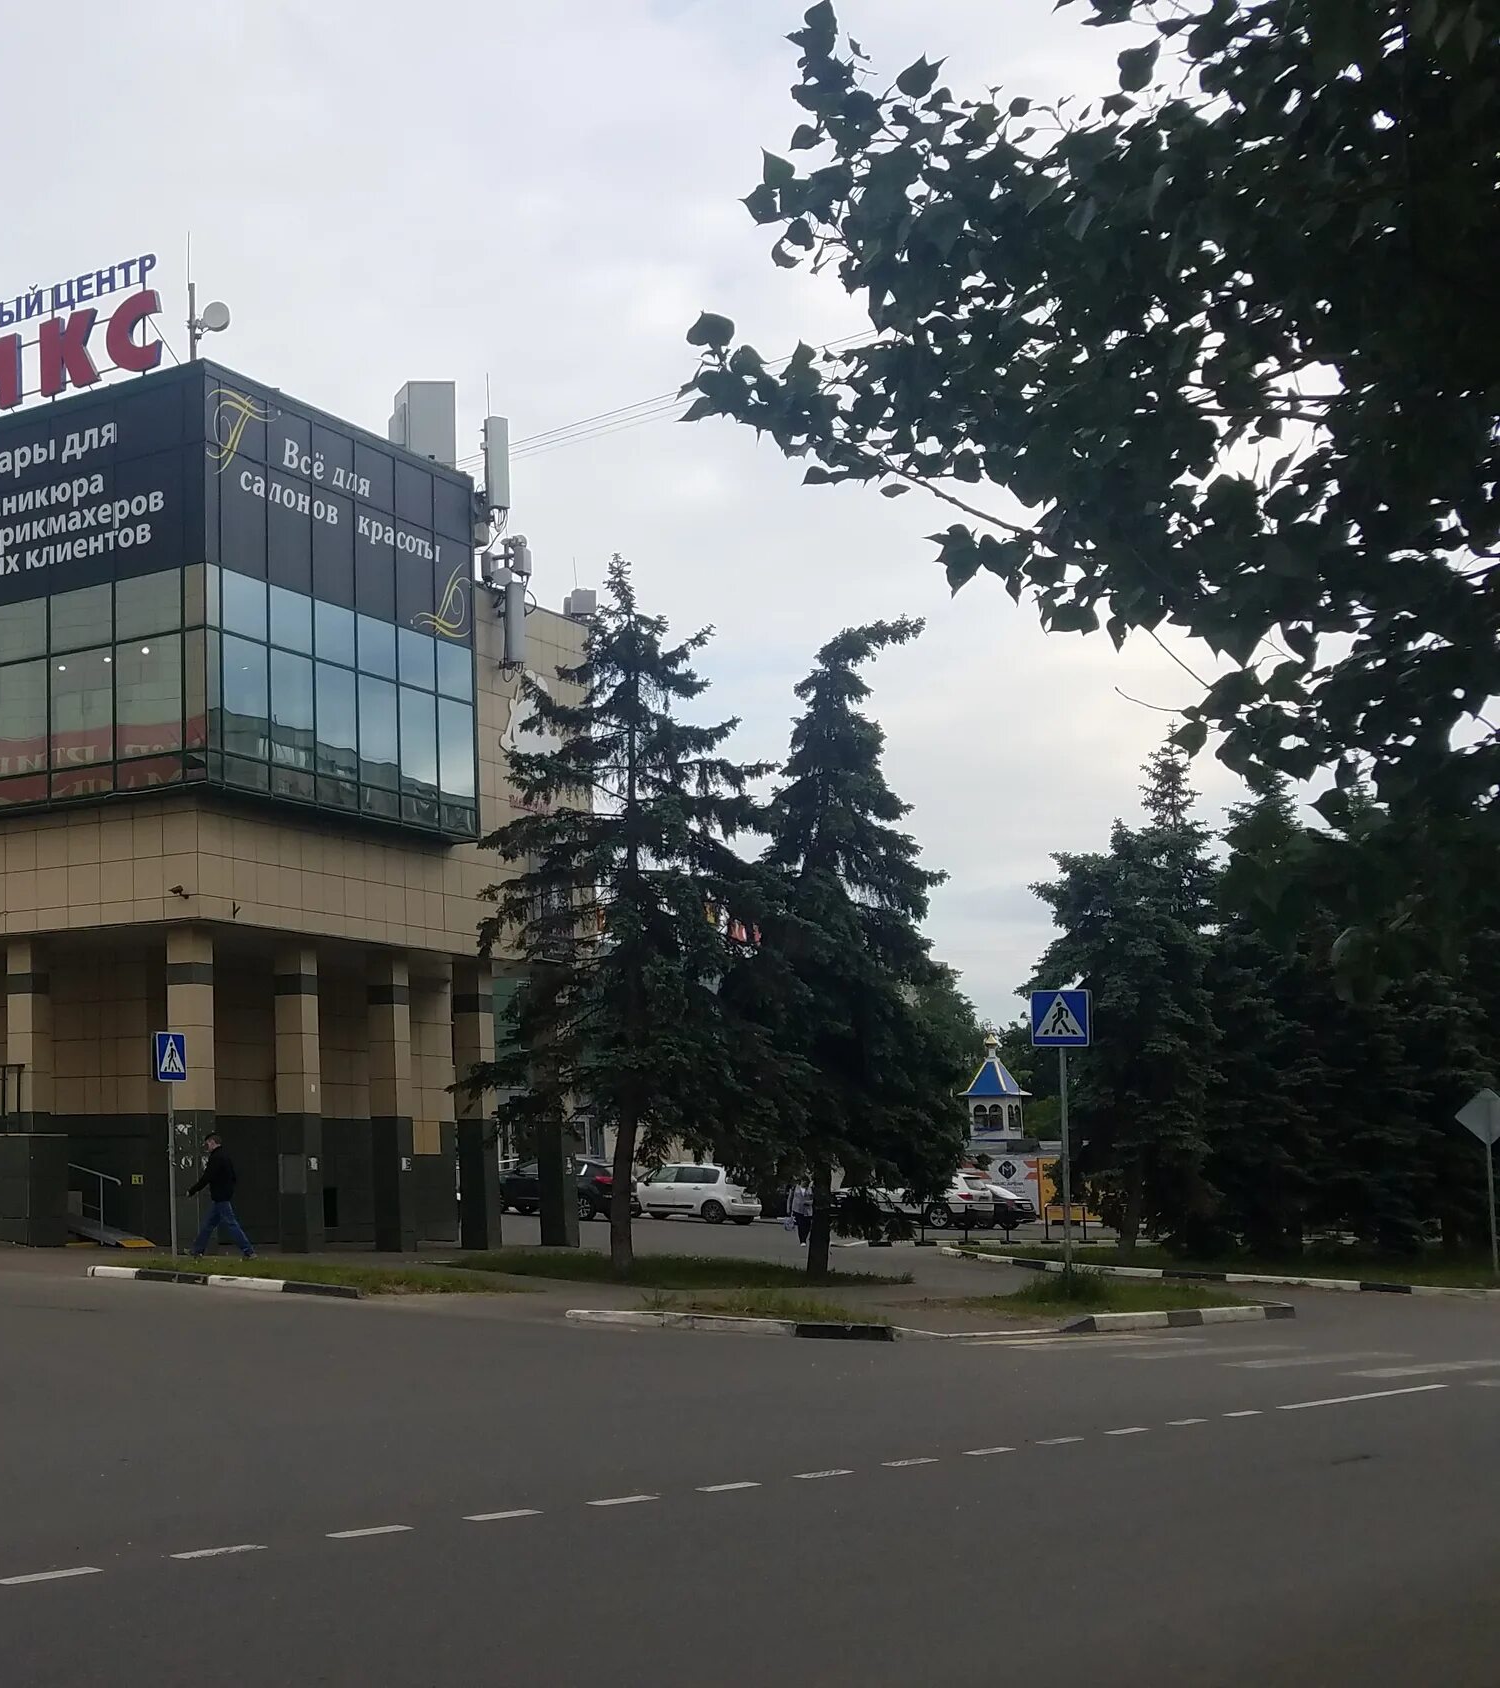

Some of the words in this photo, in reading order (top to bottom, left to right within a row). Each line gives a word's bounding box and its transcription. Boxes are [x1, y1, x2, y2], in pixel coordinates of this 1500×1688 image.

[53, 253, 157, 310] ЦЕНТР
[62, 422, 117, 463] для
[283, 438, 324, 480] Всё
[332, 467, 370, 498] для
[240, 470, 338, 525] салонов
[358, 515, 440, 562] красоты
[26, 523, 151, 574] клиентов
